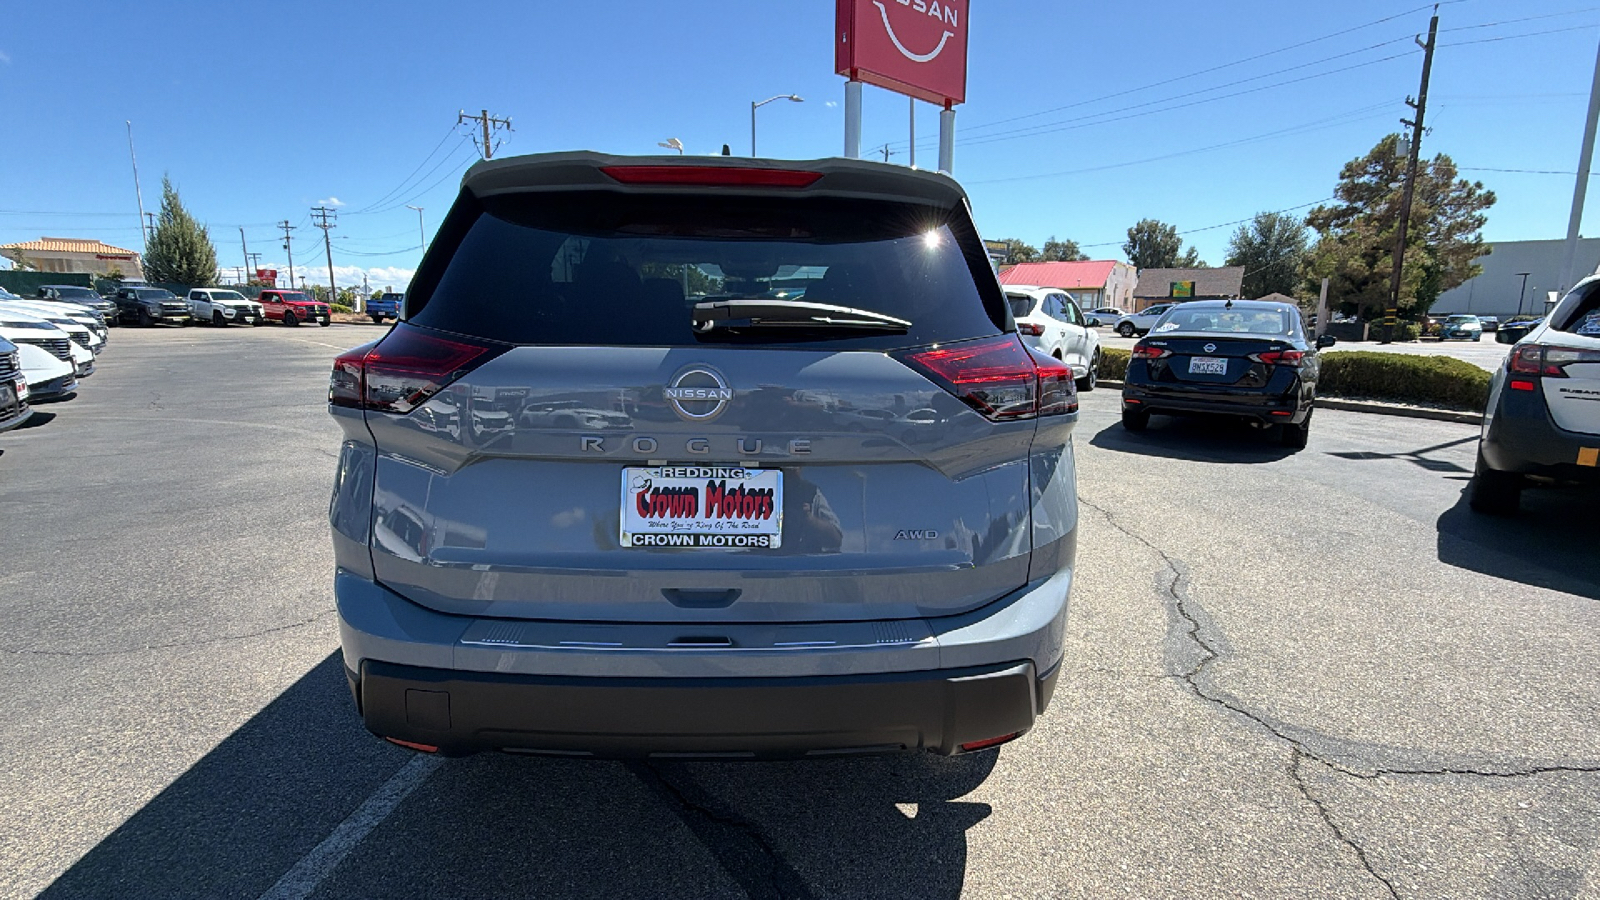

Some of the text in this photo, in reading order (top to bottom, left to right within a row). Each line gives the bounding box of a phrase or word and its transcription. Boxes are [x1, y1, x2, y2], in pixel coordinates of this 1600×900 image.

[667, 389, 731, 399] NISSAN
[580, 436, 811, 454] ROGUE
[661, 468, 744, 478] REDDING
[636, 479, 774, 520] Crown Motors
[648, 520, 669, 528] Where
[695, 521, 713, 530] King
[714, 521, 725, 530] Of
[726, 521, 739, 529] The
[741, 521, 760, 529] Road
[632, 534, 769, 547] CROWN MOTORS
[893, 529, 939, 541] AWD
